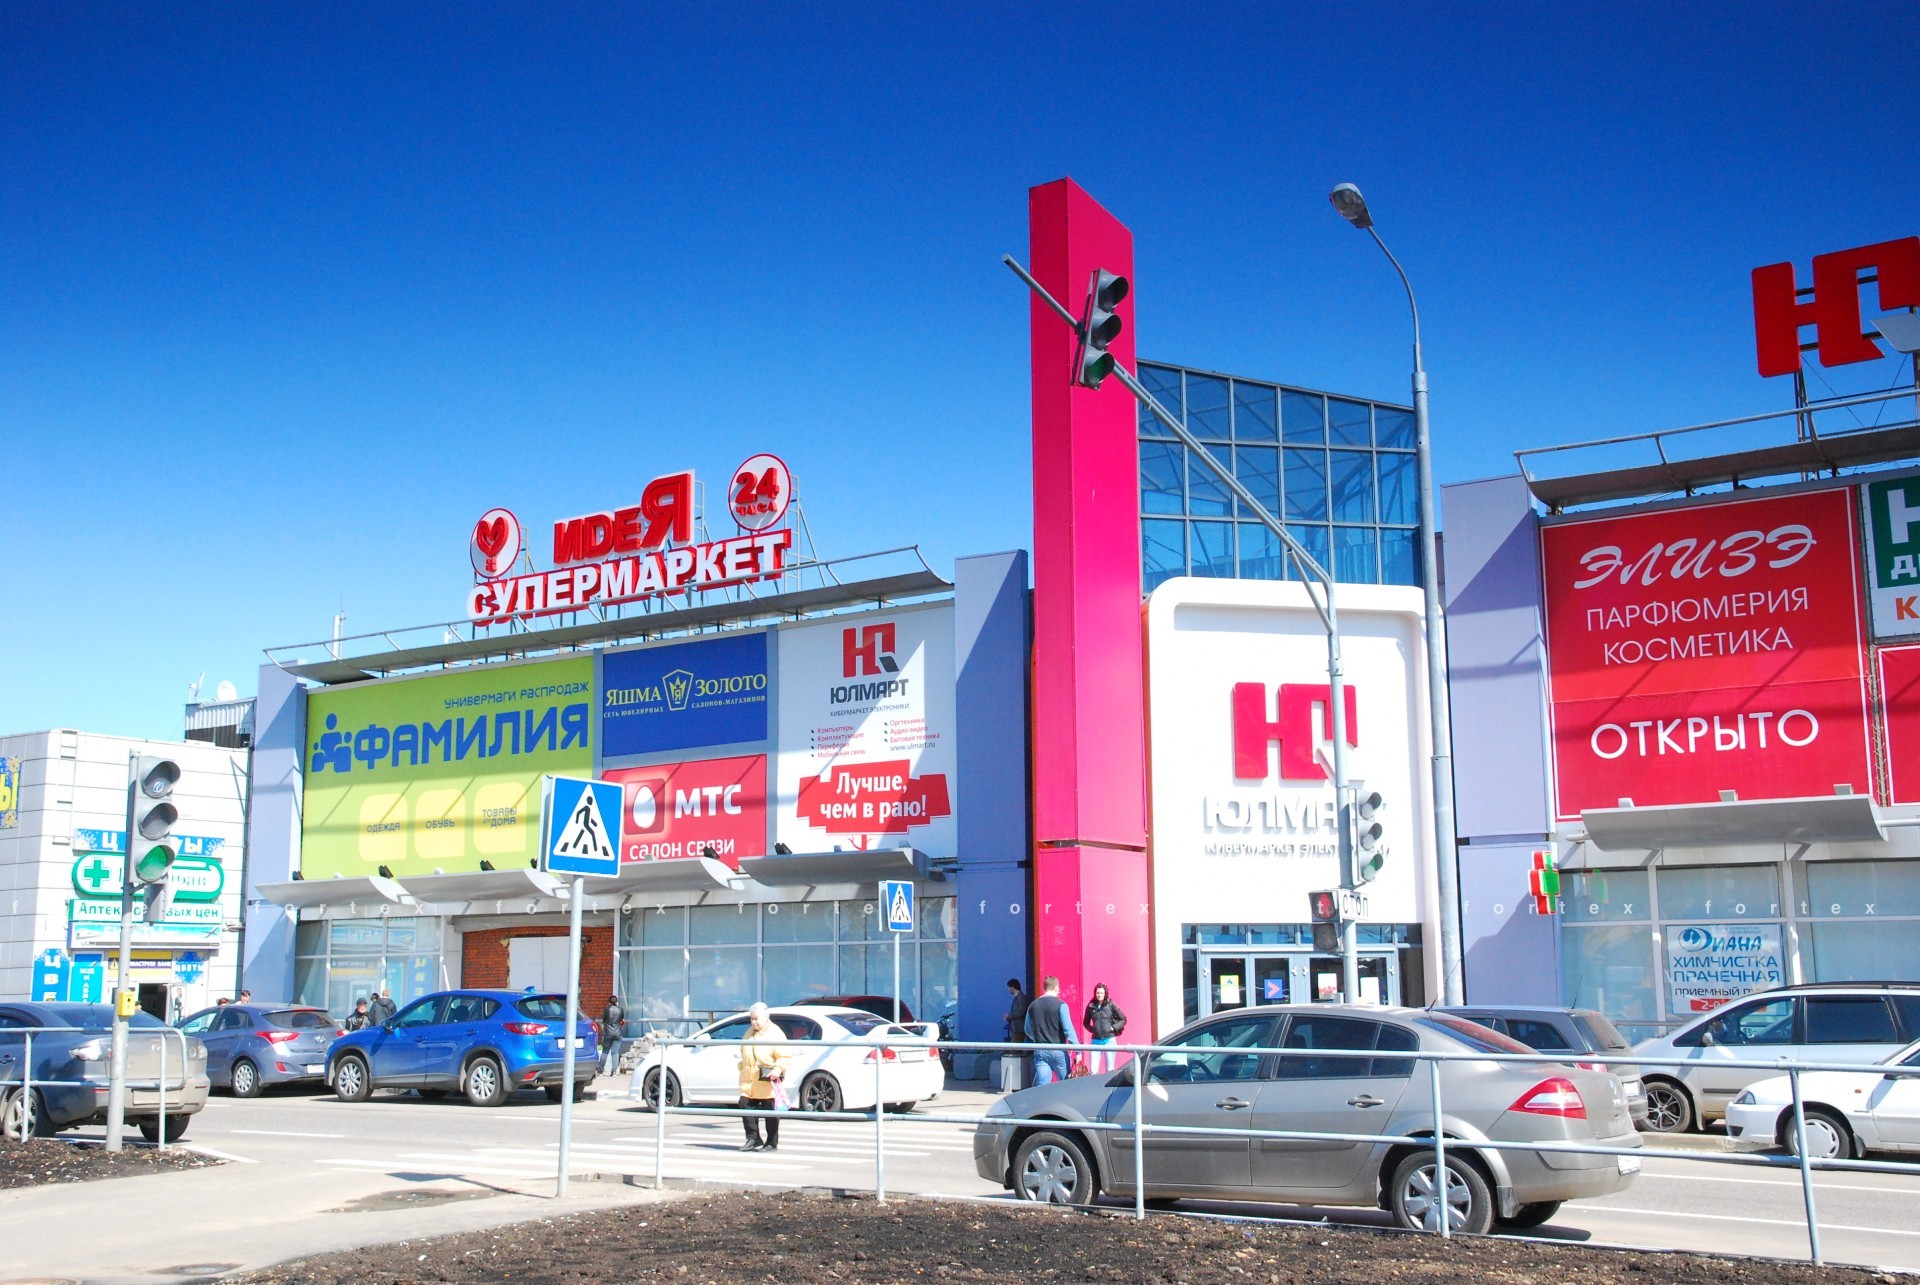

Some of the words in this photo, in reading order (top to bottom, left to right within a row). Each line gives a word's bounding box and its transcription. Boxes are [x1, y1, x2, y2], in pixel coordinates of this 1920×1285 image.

[735, 467, 779, 504] 24
[736, 501, 777, 516] ЧАСА
[1573, 524, 1816, 589] ЭЛИЗЭ
[469, 530, 789, 624] СУПЕРМАРКЕТ
[1587, 586, 1808, 631] ПАРФЮМЕРИЯ
[1603, 626, 1793, 666] КОСМЕТИКА
[694, 674, 767, 697] ЗОЛОТО
[831, 679, 909, 704] ЮЛМАРТ
[606, 686, 662, 706] ЯШМА
[830, 707, 869, 717] КИБЕРМАРКЕТ
[869, 703, 910, 713] ЭЛЕКТРОНИКИ
[354, 703, 589, 770] ФАМИЛИЯ
[817, 725, 854, 734] Компьютеры
[817, 732, 864, 742] Комплектующие
[1591, 709, 1819, 759] ОТКРЫТО
[890, 741, 936, 752] www.ulmart.ru
[836, 772, 907, 800] Лучше,
[675, 784, 742, 818] МТС
[820, 802, 857, 819] чем
[862, 802, 874, 817] в
[879, 794, 927, 825] раю!
[482, 807, 517, 817] ТОВАРЫ
[491, 816, 516, 828] ДОМА
[367, 822, 400, 833] ОДЕЖДА
[425, 819, 455, 829] ОБУВЬ
[195, 908, 218, 918] цен
[1342, 893, 1369, 917] СТОП
[1673, 956, 1778, 968] ХИМЧИСТКА
[1674, 970, 1780, 982] ПРАЧЕЧНАЯ
[1675, 987, 1740, 998] приемный
